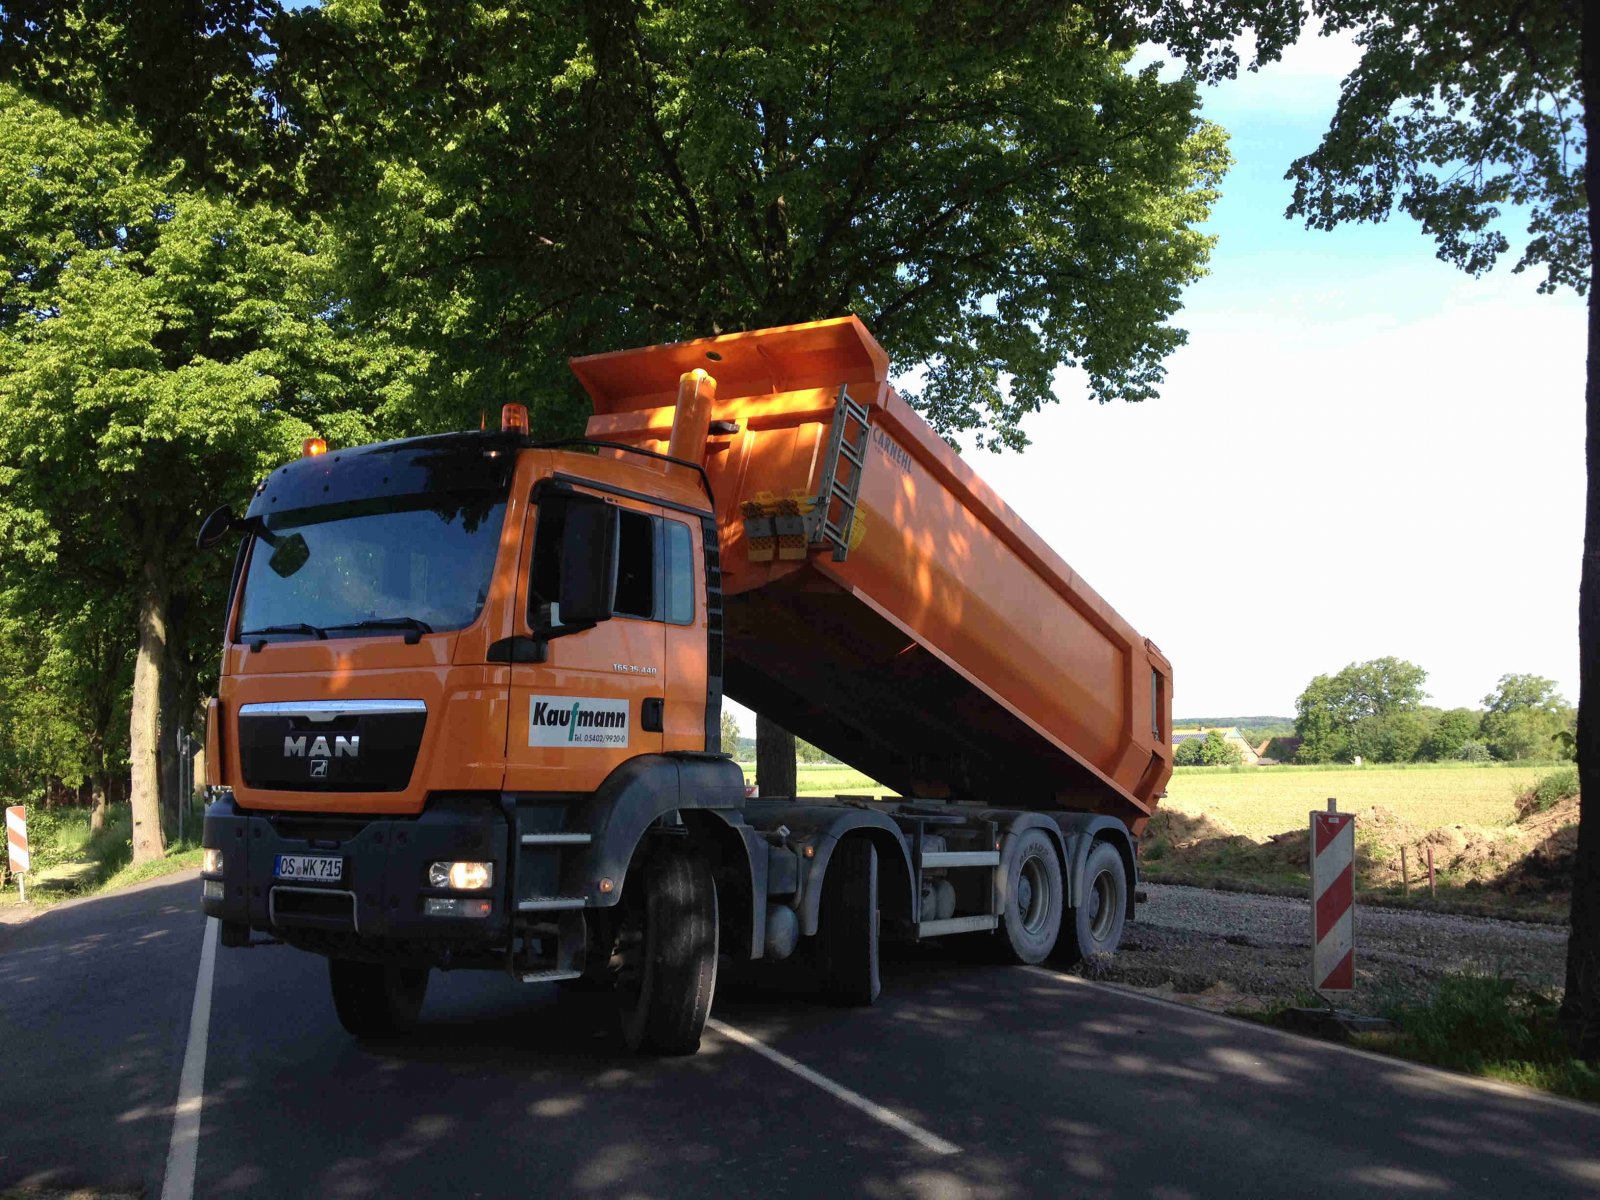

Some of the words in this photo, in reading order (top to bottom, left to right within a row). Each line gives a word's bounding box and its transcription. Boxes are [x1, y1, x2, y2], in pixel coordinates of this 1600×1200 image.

[873, 427, 912, 474] CARNEHL
[533, 702, 626, 741] Kaufmann
[283, 735, 360, 757] MAN
[584, 734, 626, 743] 05402/9920-0
[280, 857, 295, 875] OS
[302, 858, 317, 876] WK
[320, 859, 342, 877] 715
